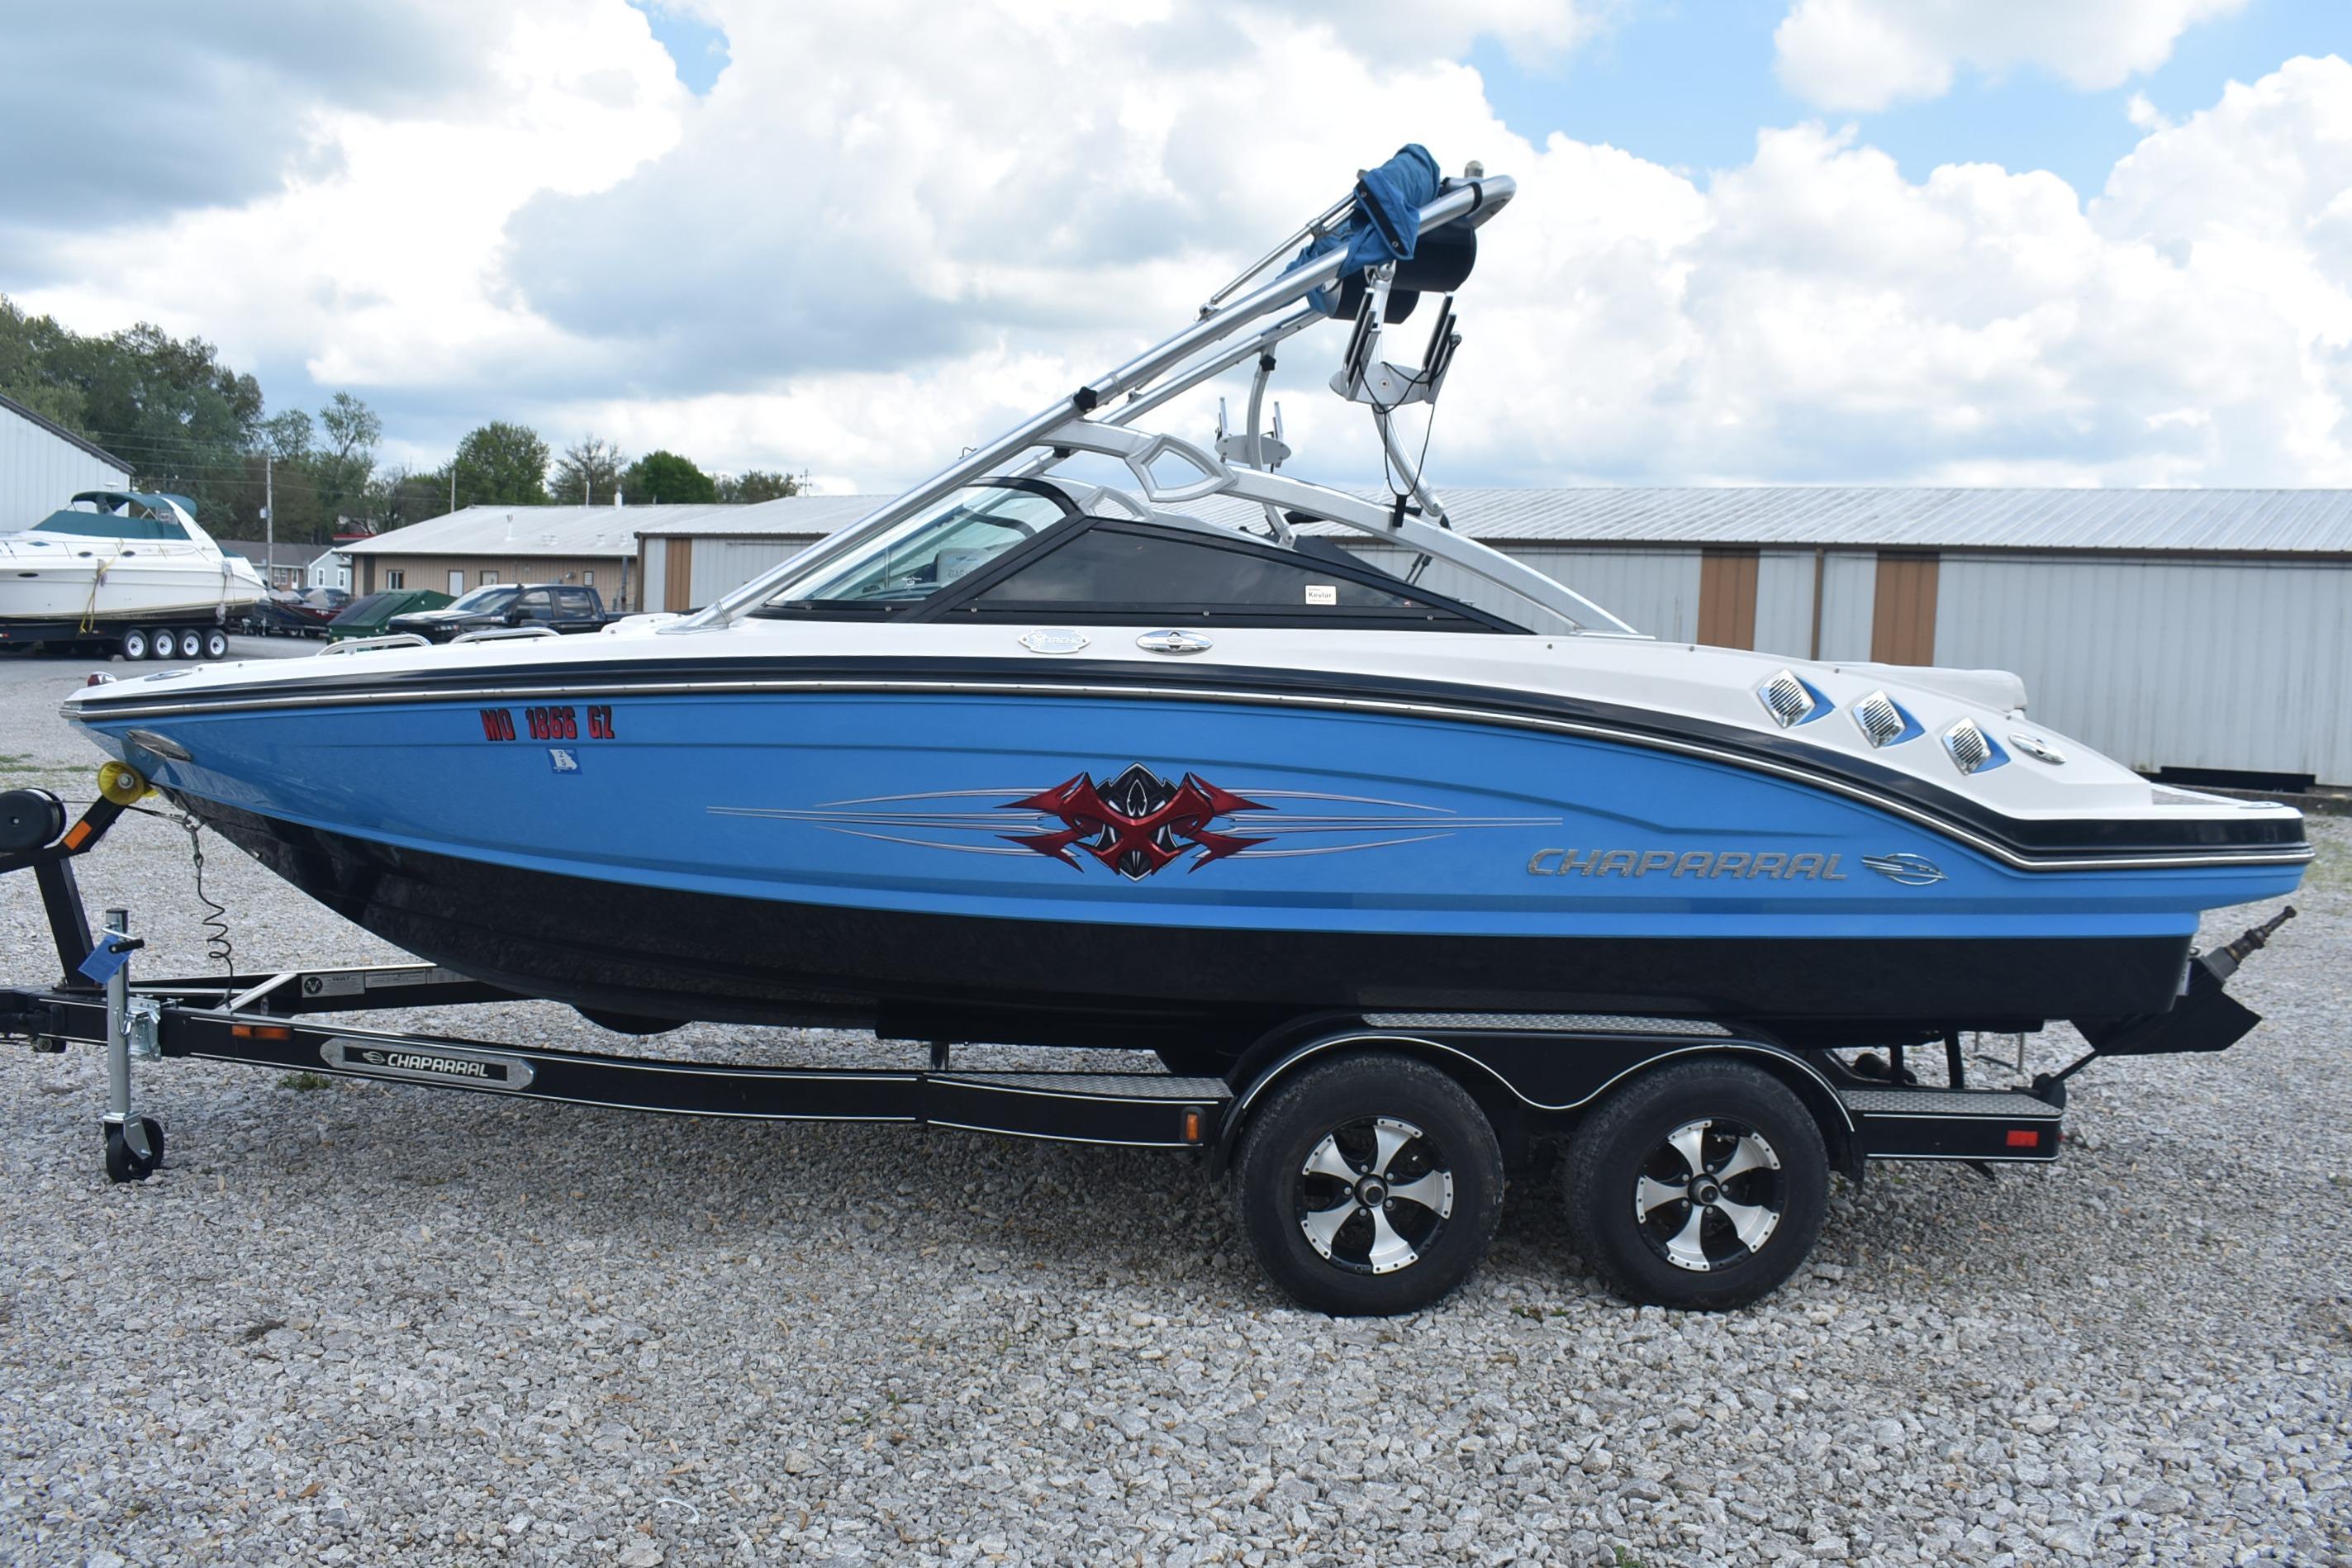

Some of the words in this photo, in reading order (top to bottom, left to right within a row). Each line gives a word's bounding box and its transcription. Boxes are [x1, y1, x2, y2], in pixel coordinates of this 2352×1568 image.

[479, 708, 516, 741] MO
[525, 706, 578, 740] 1866
[1527, 848, 1848, 881] CHAPARRAL
[387, 1052, 489, 1078] CHAPARRAL
